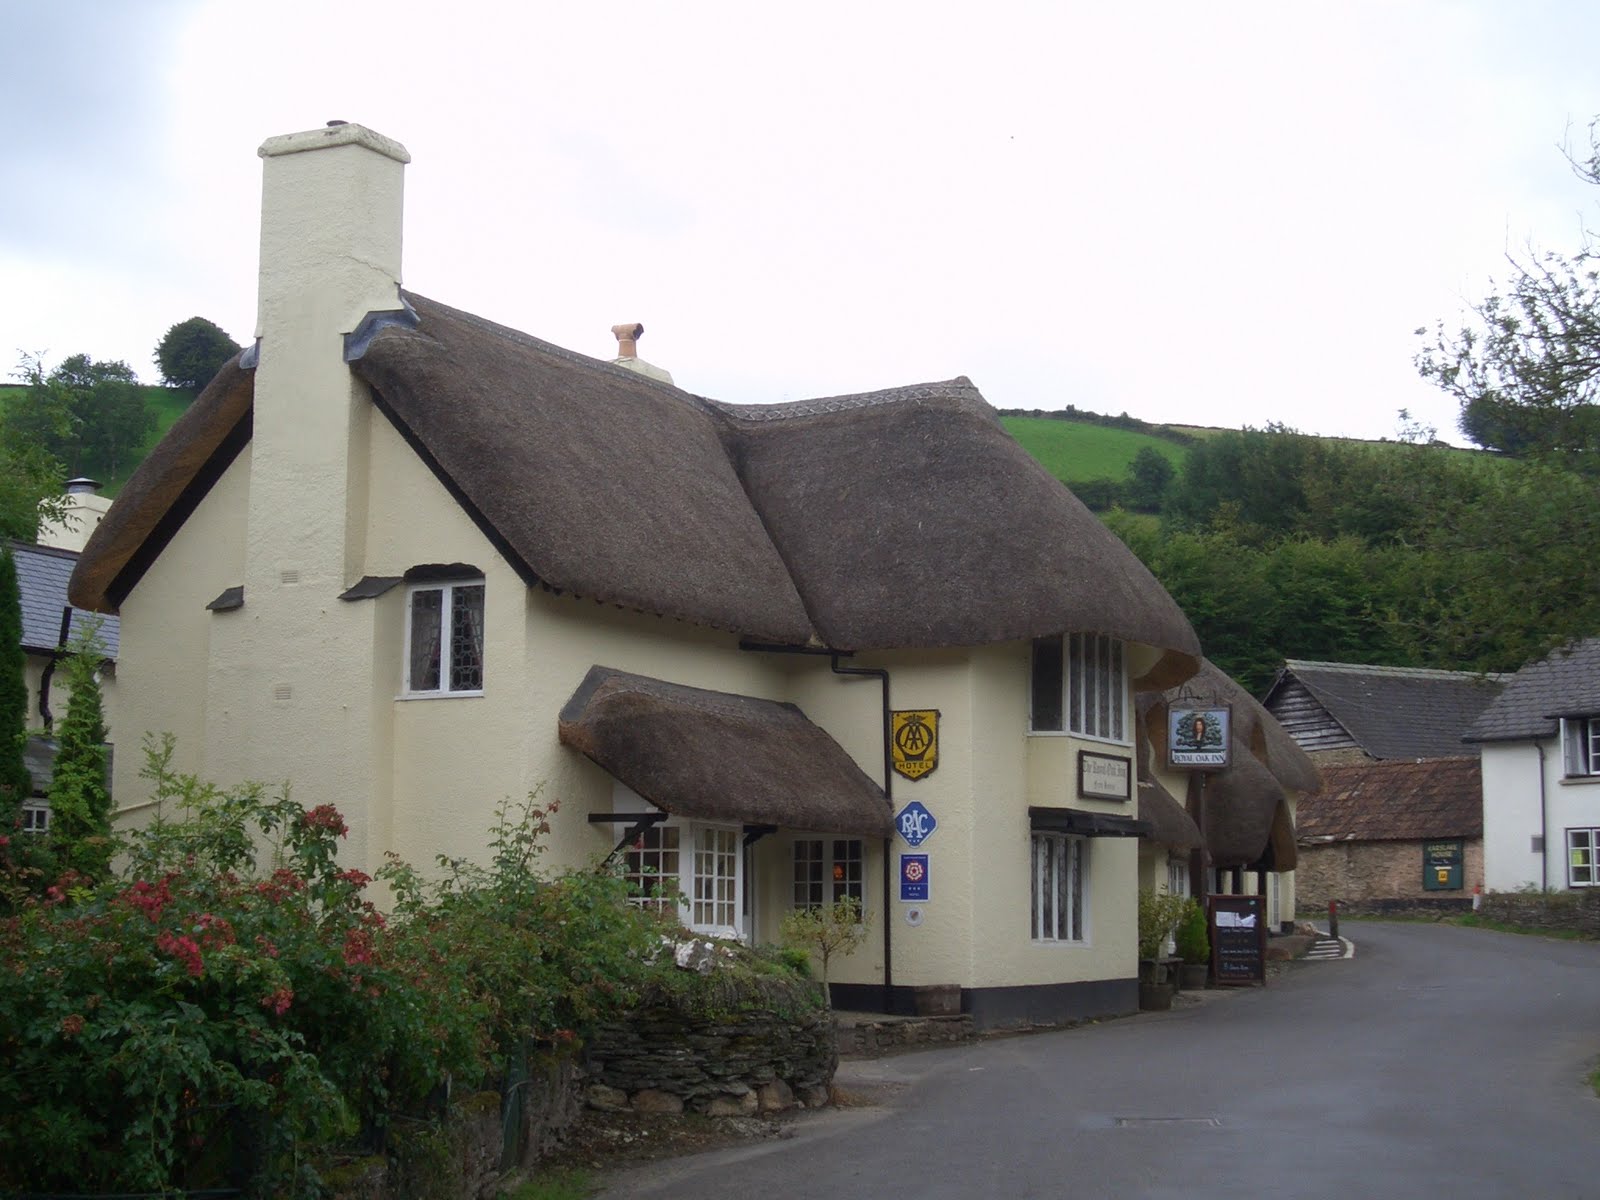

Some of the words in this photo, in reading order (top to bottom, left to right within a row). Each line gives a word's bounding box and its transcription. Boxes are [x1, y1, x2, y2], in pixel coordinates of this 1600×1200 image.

[1175, 754, 1193, 762] ROYAL
[1195, 754, 1210, 762] OAK
[1211, 754, 1225, 762] INN
[901, 810, 928, 838] RAC
